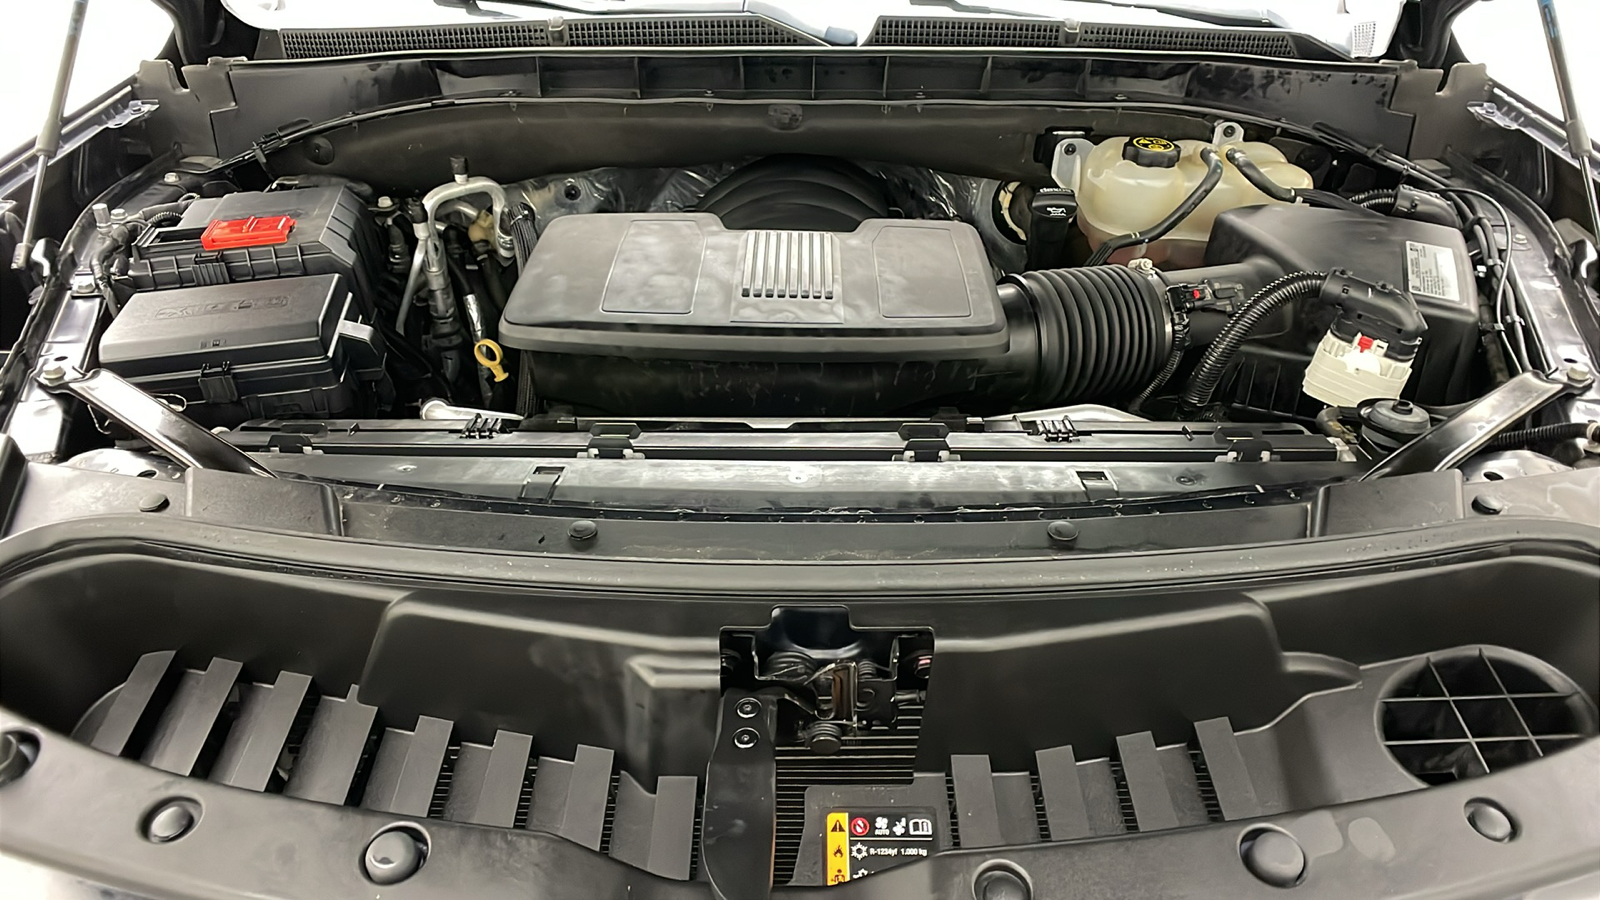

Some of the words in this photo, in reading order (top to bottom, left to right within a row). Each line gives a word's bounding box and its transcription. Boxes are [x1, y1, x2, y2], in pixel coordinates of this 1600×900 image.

[869, 848, 898, 857] R-1234yf
[900, 848, 918, 856] 1.000
[918, 848, 928, 857] kg
